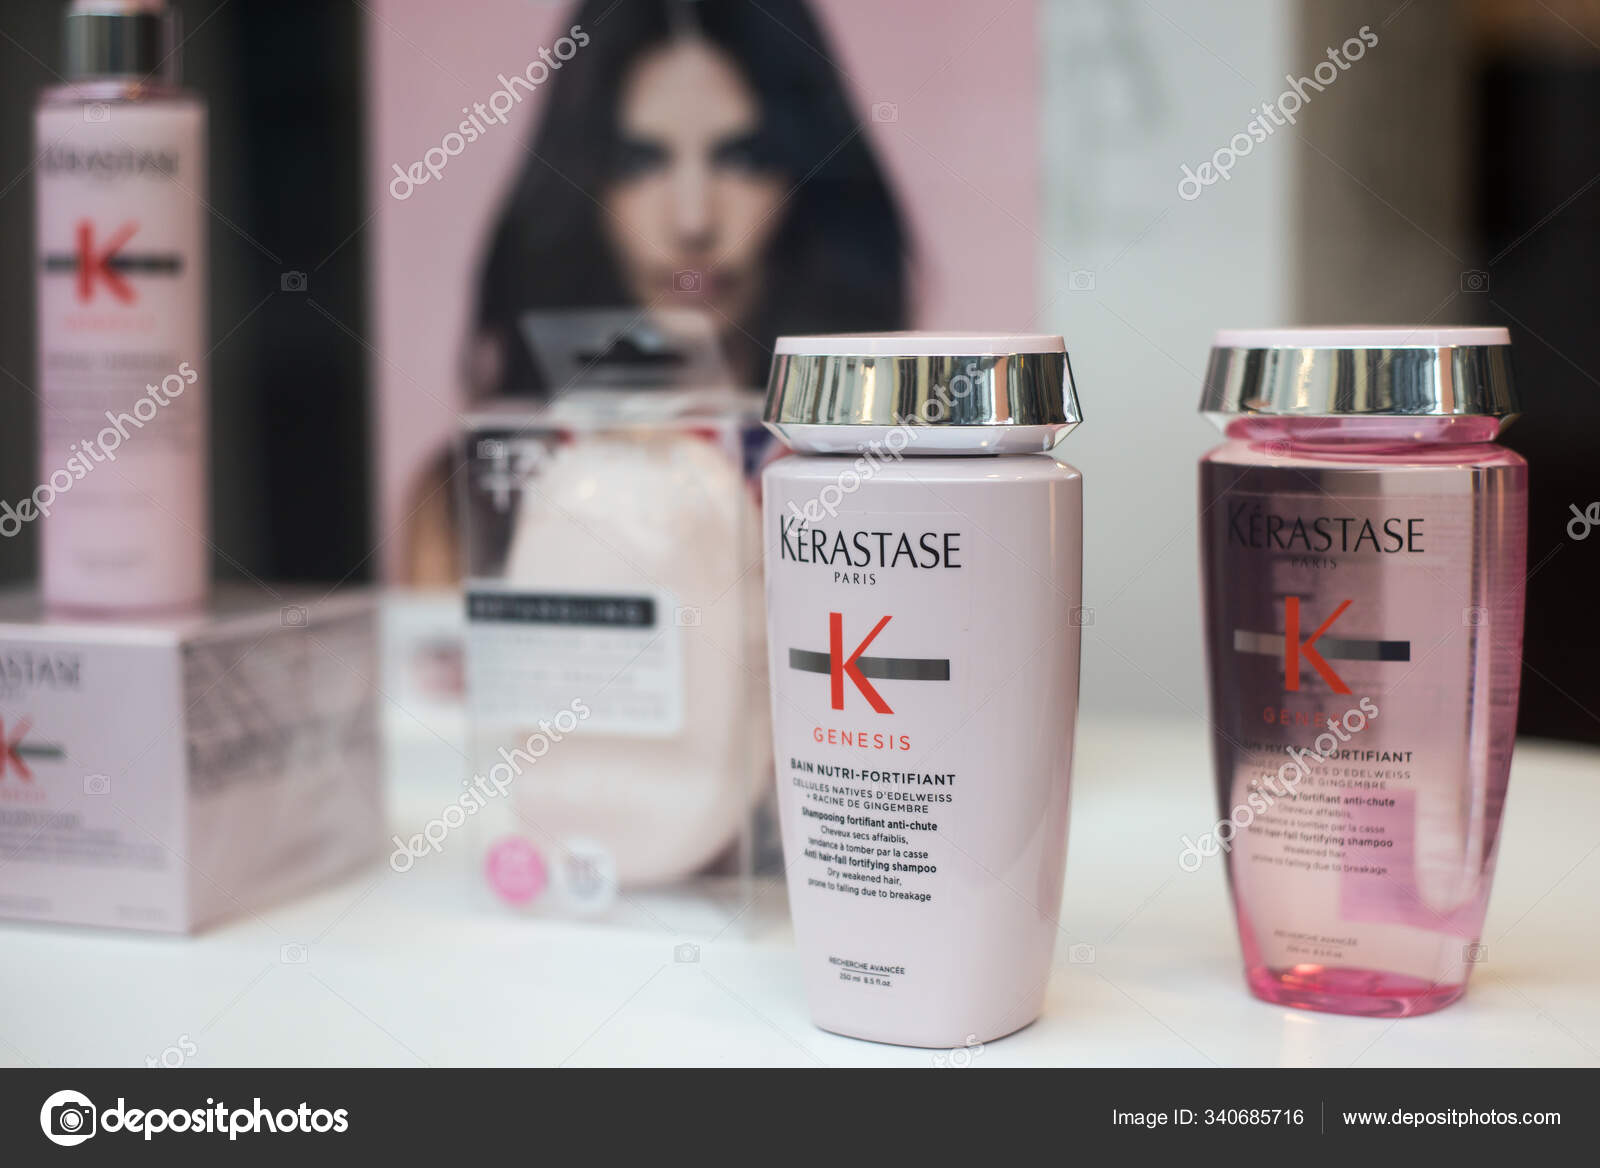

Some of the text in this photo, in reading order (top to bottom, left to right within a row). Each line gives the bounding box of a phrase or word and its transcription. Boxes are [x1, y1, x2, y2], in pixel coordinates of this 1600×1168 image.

[1227, 500, 1425, 553] KÉRASTASE
[780, 514, 962, 569] KÉRASTASE
[1291, 557, 1337, 569] PARIS
[834, 572, 876, 585] PARIS
[1285, 596, 1353, 695] K
[829, 612, 895, 715] K
[1264, 706, 1369, 730] GENE
[813, 727, 911, 751] GENESIS
[1265, 743, 1413, 763] HYORTIFIANT
[791, 758, 956, 786] BAIN NUTRI-FORTIFIANT
[793, 777, 952, 803] CELLULES NATIVES D'EDELWEISS
[813, 793, 844, 807] RACINE
[847, 800, 860, 809] DE
[864, 801, 929, 814] GINGEMBRE
[1343, 796, 1395, 808] anti-chute
[802, 806, 938, 832] Shampooing fortifiant anti-chute
[820, 825, 909, 845] Cheveux secs affaiblis,
[1347, 836, 1393, 849] shampoo
[804, 846, 937, 875] Anti hair-fall fortifying shampoo
[846, 843, 876, 855] tomber
[876, 848, 891, 858] par
[893, 847, 902, 858] la
[903, 849, 929, 860] casse
[827, 866, 840, 880] Dry
[842, 871, 881, 884] weakened
[836, 881, 859, 896] falling
[861, 886, 877, 897] due
[878, 889, 888, 898] to
[889, 889, 932, 903] breakage
[869, 963, 905, 975] AVANCÉE
